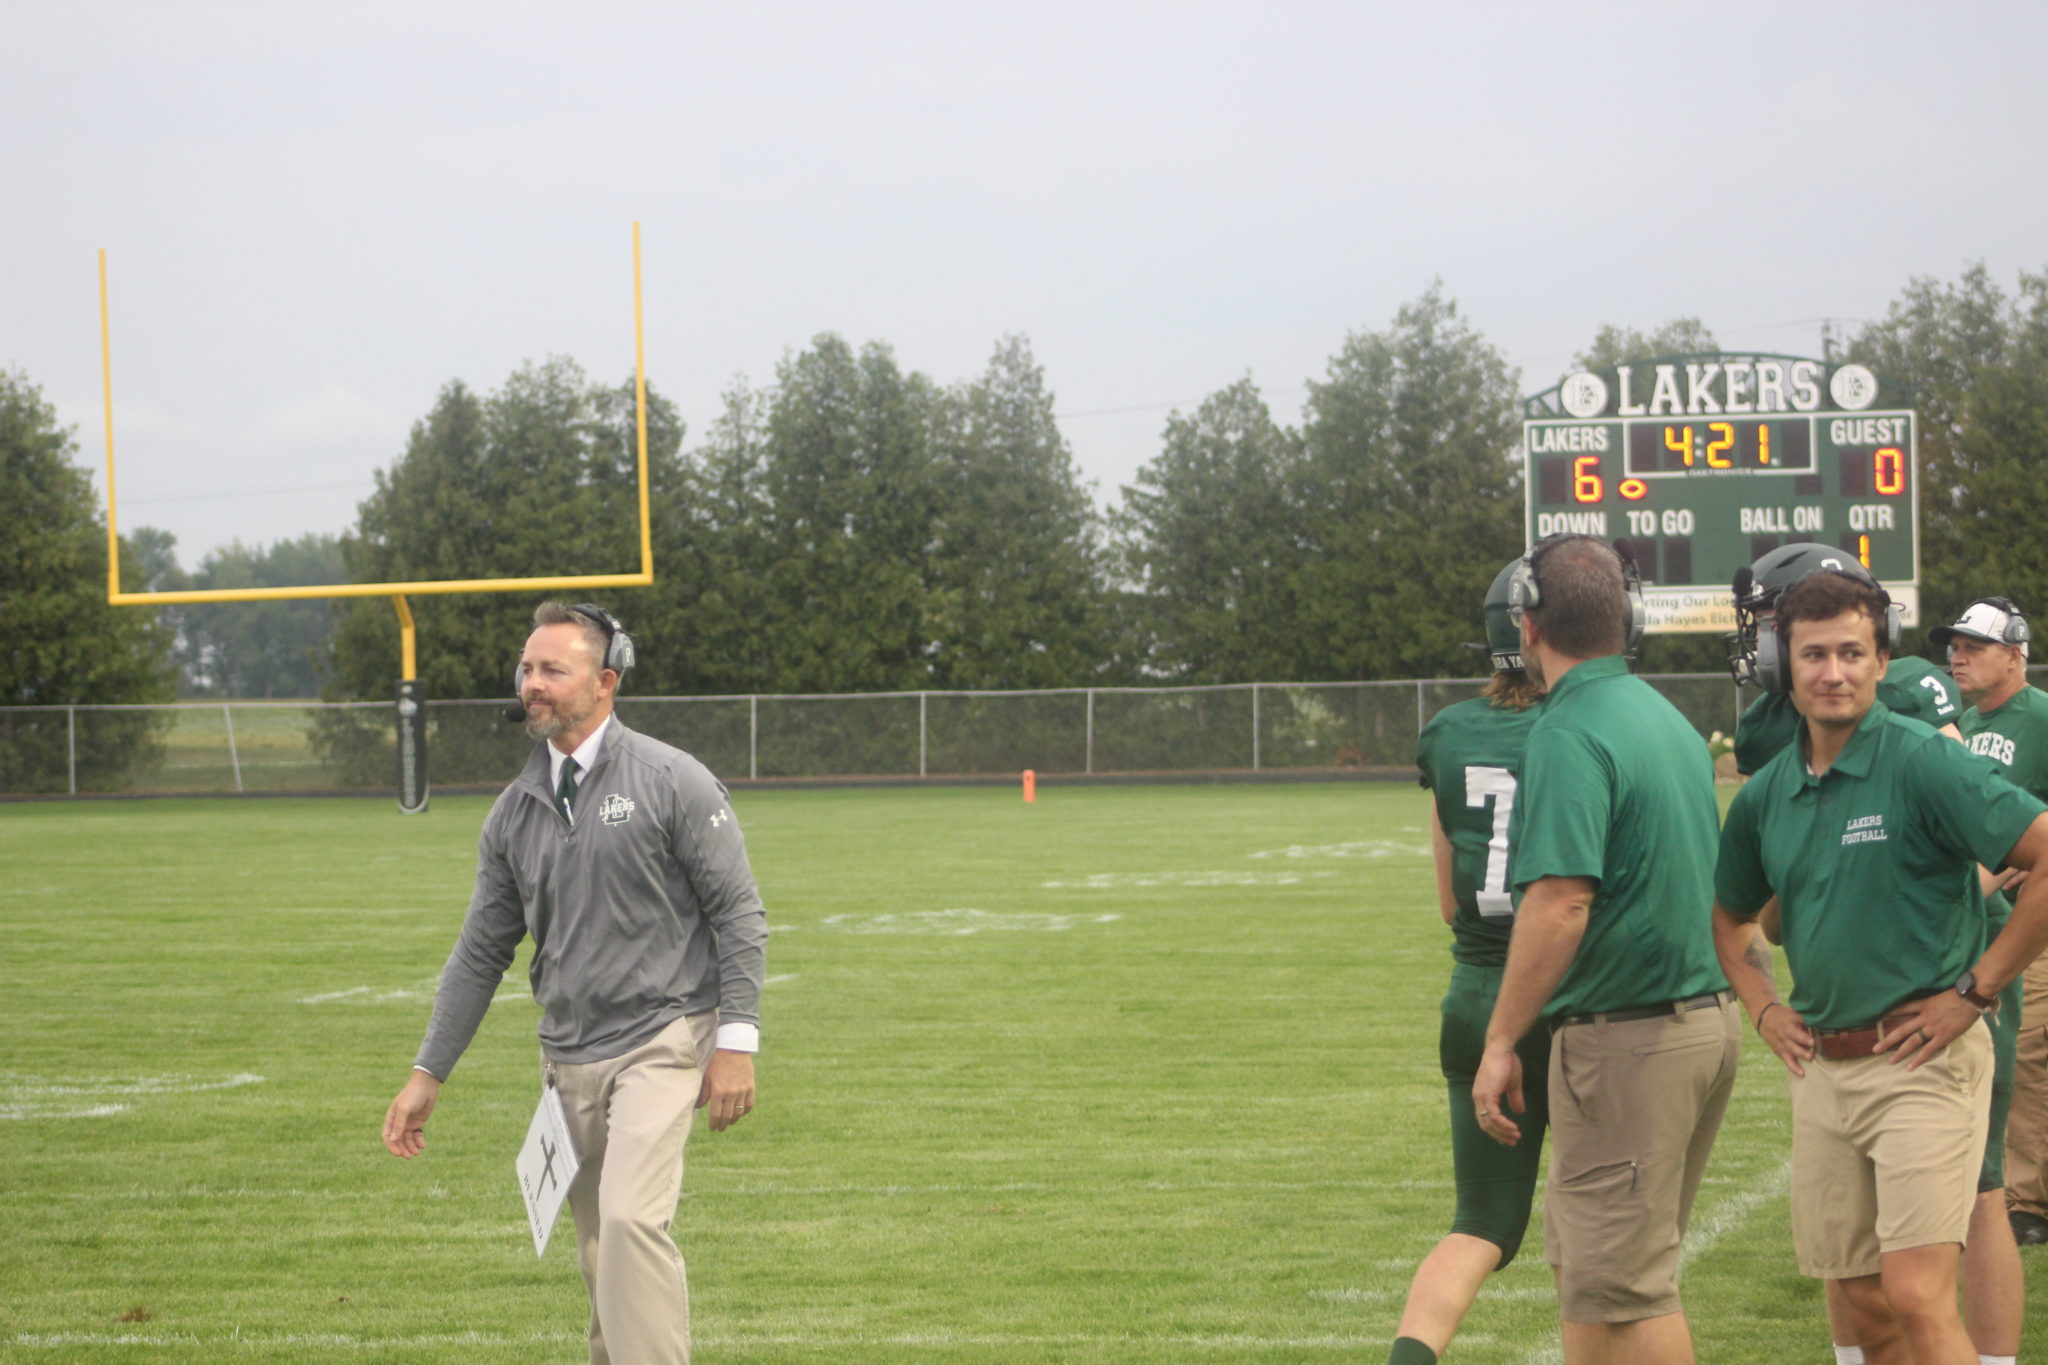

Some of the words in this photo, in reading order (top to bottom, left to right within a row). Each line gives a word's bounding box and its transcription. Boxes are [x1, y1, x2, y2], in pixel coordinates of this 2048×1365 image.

[1618, 363, 1821, 416] LAKERS
[1531, 427, 1608, 452] LAKERS
[1830, 419, 1906, 444] GUEST
[1573, 456, 1603, 503] 6
[1874, 448, 1904, 495] 0
[1538, 512, 1607, 537] DOWN
[1626, 510, 1657, 536] TO
[1661, 509, 1694, 536] GO
[1740, 508, 1790, 532] BALL
[1793, 506, 1823, 531] ON
[1849, 505, 1894, 530] QTR
[1859, 535, 1870, 569] 1
[1645, 596, 1679, 610] rting
[1683, 596, 1708, 607] Our
[1664, 613, 1707, 628] Hayes
[1710, 611, 1737, 625] Eich
[1920, 676, 1948, 705] 3
[1965, 732, 2015, 766] KERS
[600, 801, 635, 817] LAKERS
[1846, 815, 1882, 830] LAKERS
[1465, 766, 1517, 917] 7
[1841, 829, 1887, 845] FOOTBALL
